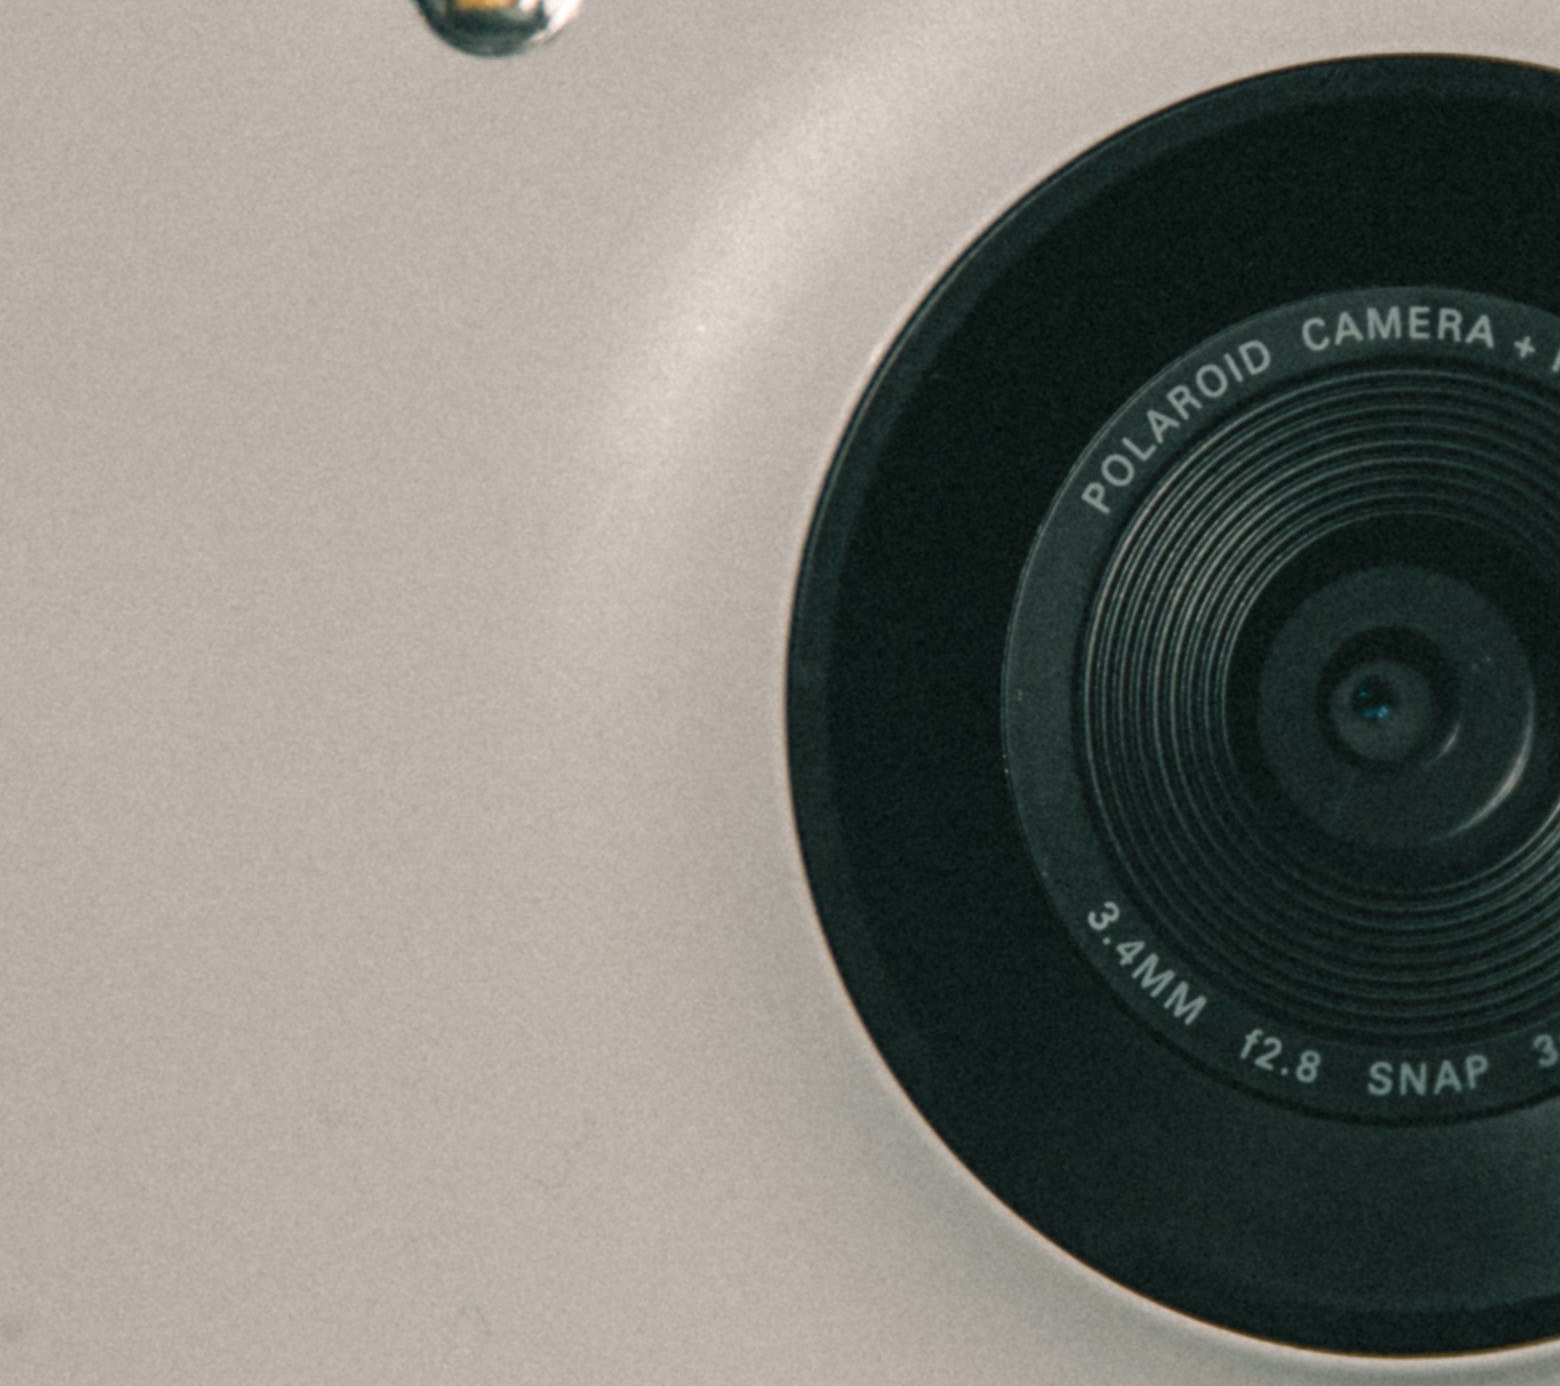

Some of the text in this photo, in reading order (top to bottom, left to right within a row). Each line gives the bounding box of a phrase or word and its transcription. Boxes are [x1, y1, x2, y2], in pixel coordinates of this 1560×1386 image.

[1080, 339, 1272, 514] POLAROID
[1301, 305, 1495, 352] CAMERA
[1513, 335, 1537, 359] +
[1087, 900, 1208, 1026] 3.4MM
[1239, 1028, 1322, 1084] f2.8
[1366, 1053, 1490, 1098] SNAP
